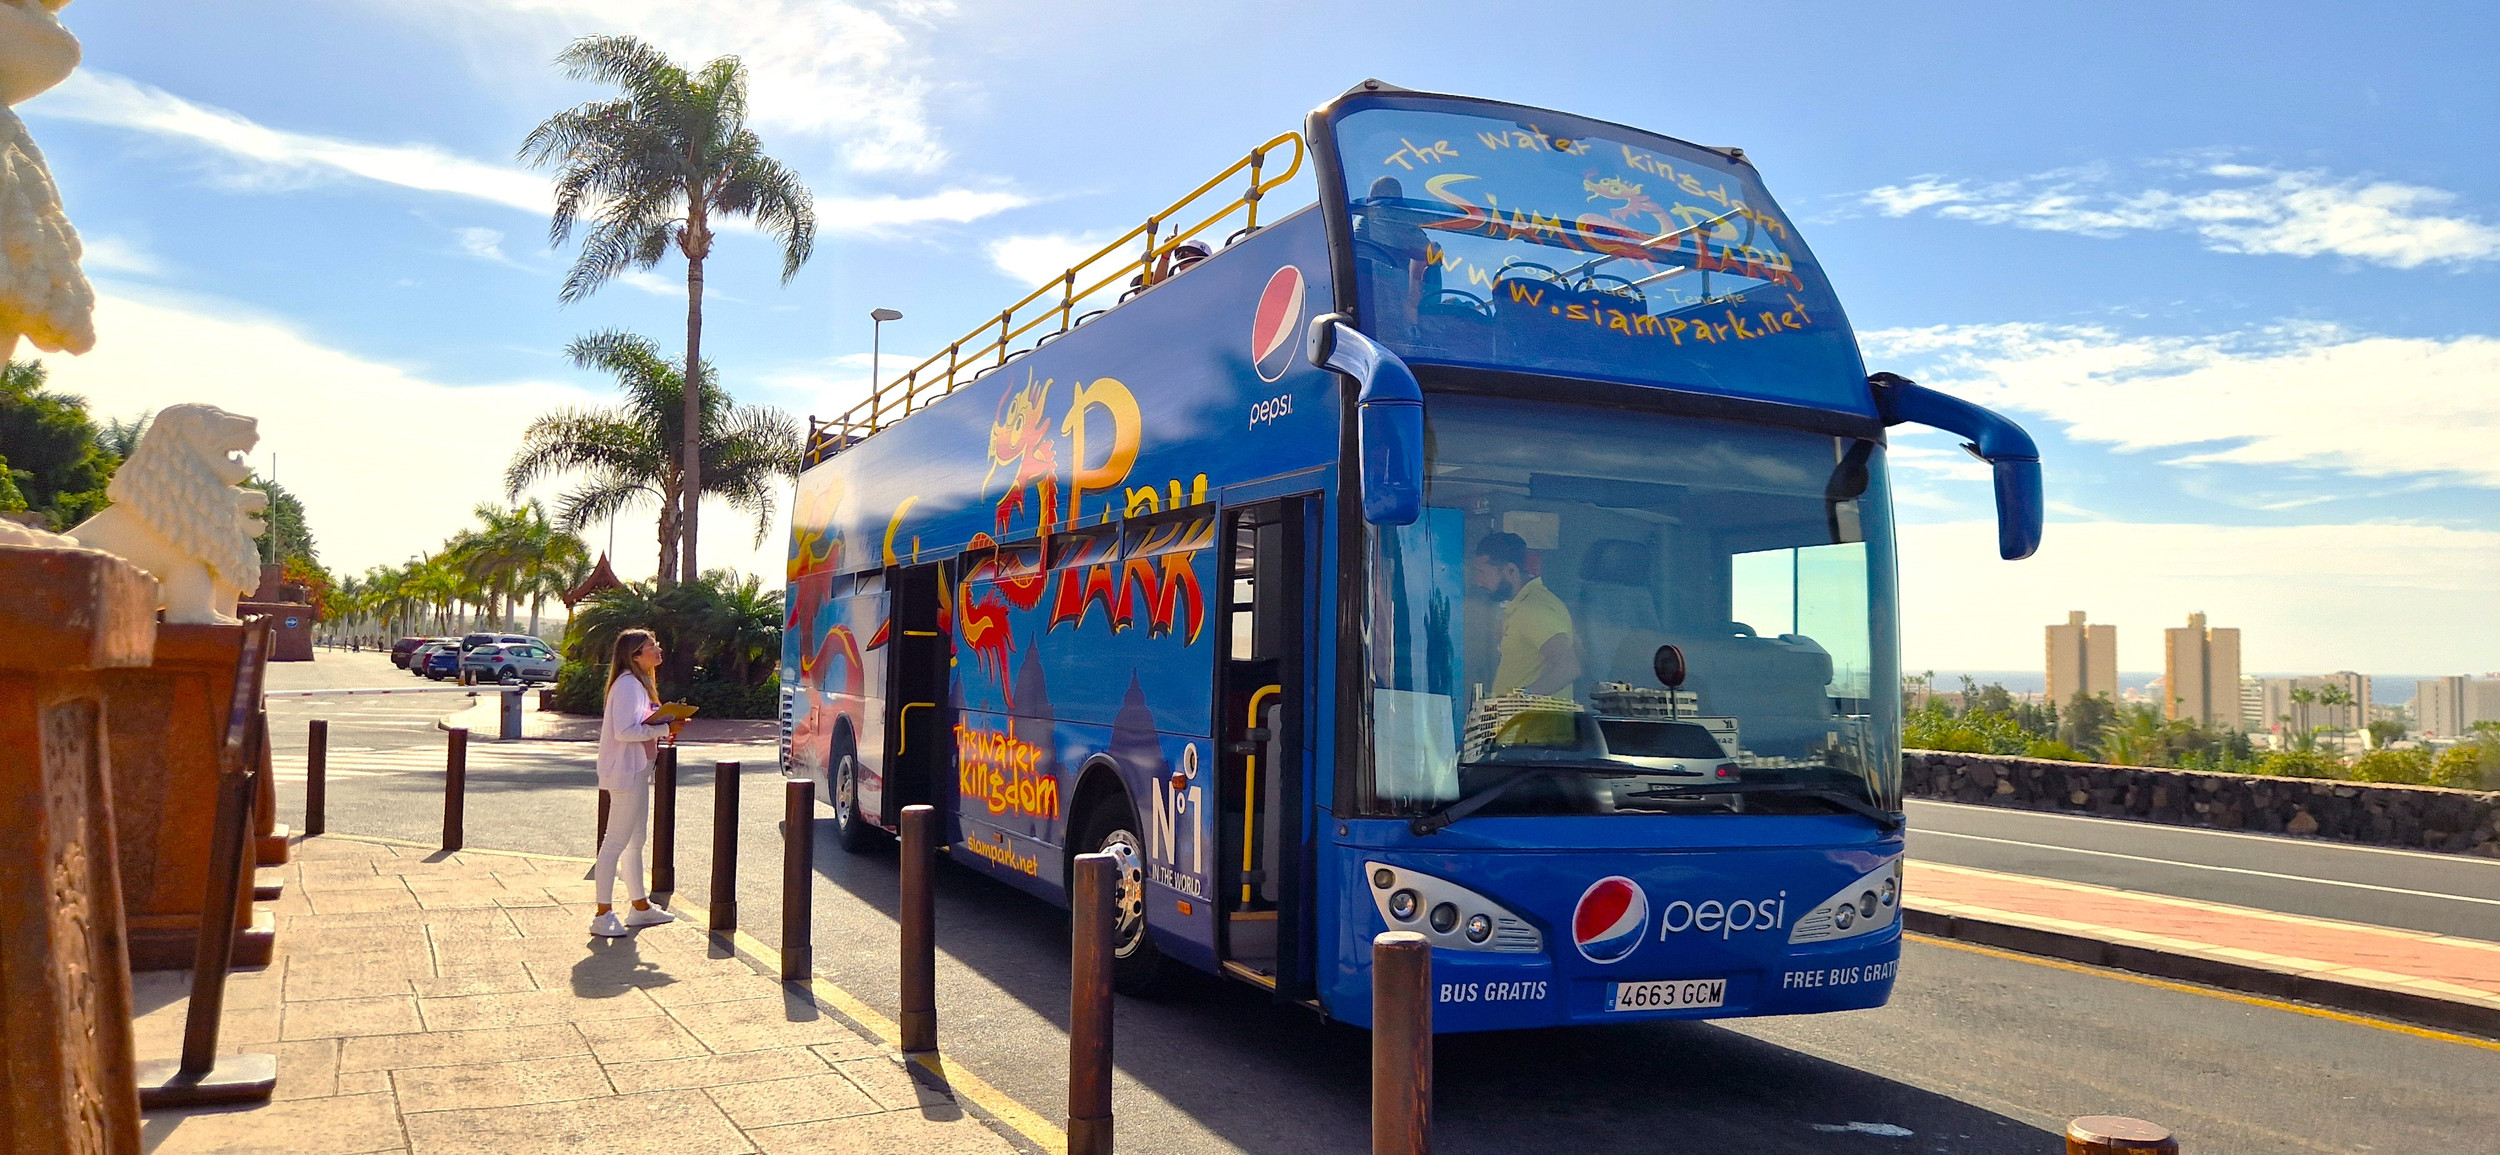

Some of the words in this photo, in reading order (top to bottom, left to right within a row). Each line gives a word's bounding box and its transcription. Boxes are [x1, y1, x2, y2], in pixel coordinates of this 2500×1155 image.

[1384, 138, 1460, 171] The
[1476, 123, 1591, 157] water
[1622, 145, 1787, 240] kingdom
[1669, 201, 1804, 293] PARK
[1249, 393, 1293, 431] pepsi
[953, 715, 977, 750] The
[978, 717, 1042, 772] water
[959, 746, 1059, 818] kingdom
[967, 830, 1038, 877] siampark.net
[1152, 863, 1160, 882] IN
[1161, 867, 1173, 889] THE
[1174, 872, 1201, 897] WORLD
[1660, 889, 1786, 942] pepsi
[1439, 982, 1479, 1003] BUS
[1484, 981, 1548, 1002] GRATIS
[1621, 984, 1675, 1007] 4663
[1682, 981, 1722, 1004] GCM
[1783, 969, 1825, 989] FREE
[1829, 966, 1860, 986] BUS
[1863, 959, 1899, 982] GRATI
